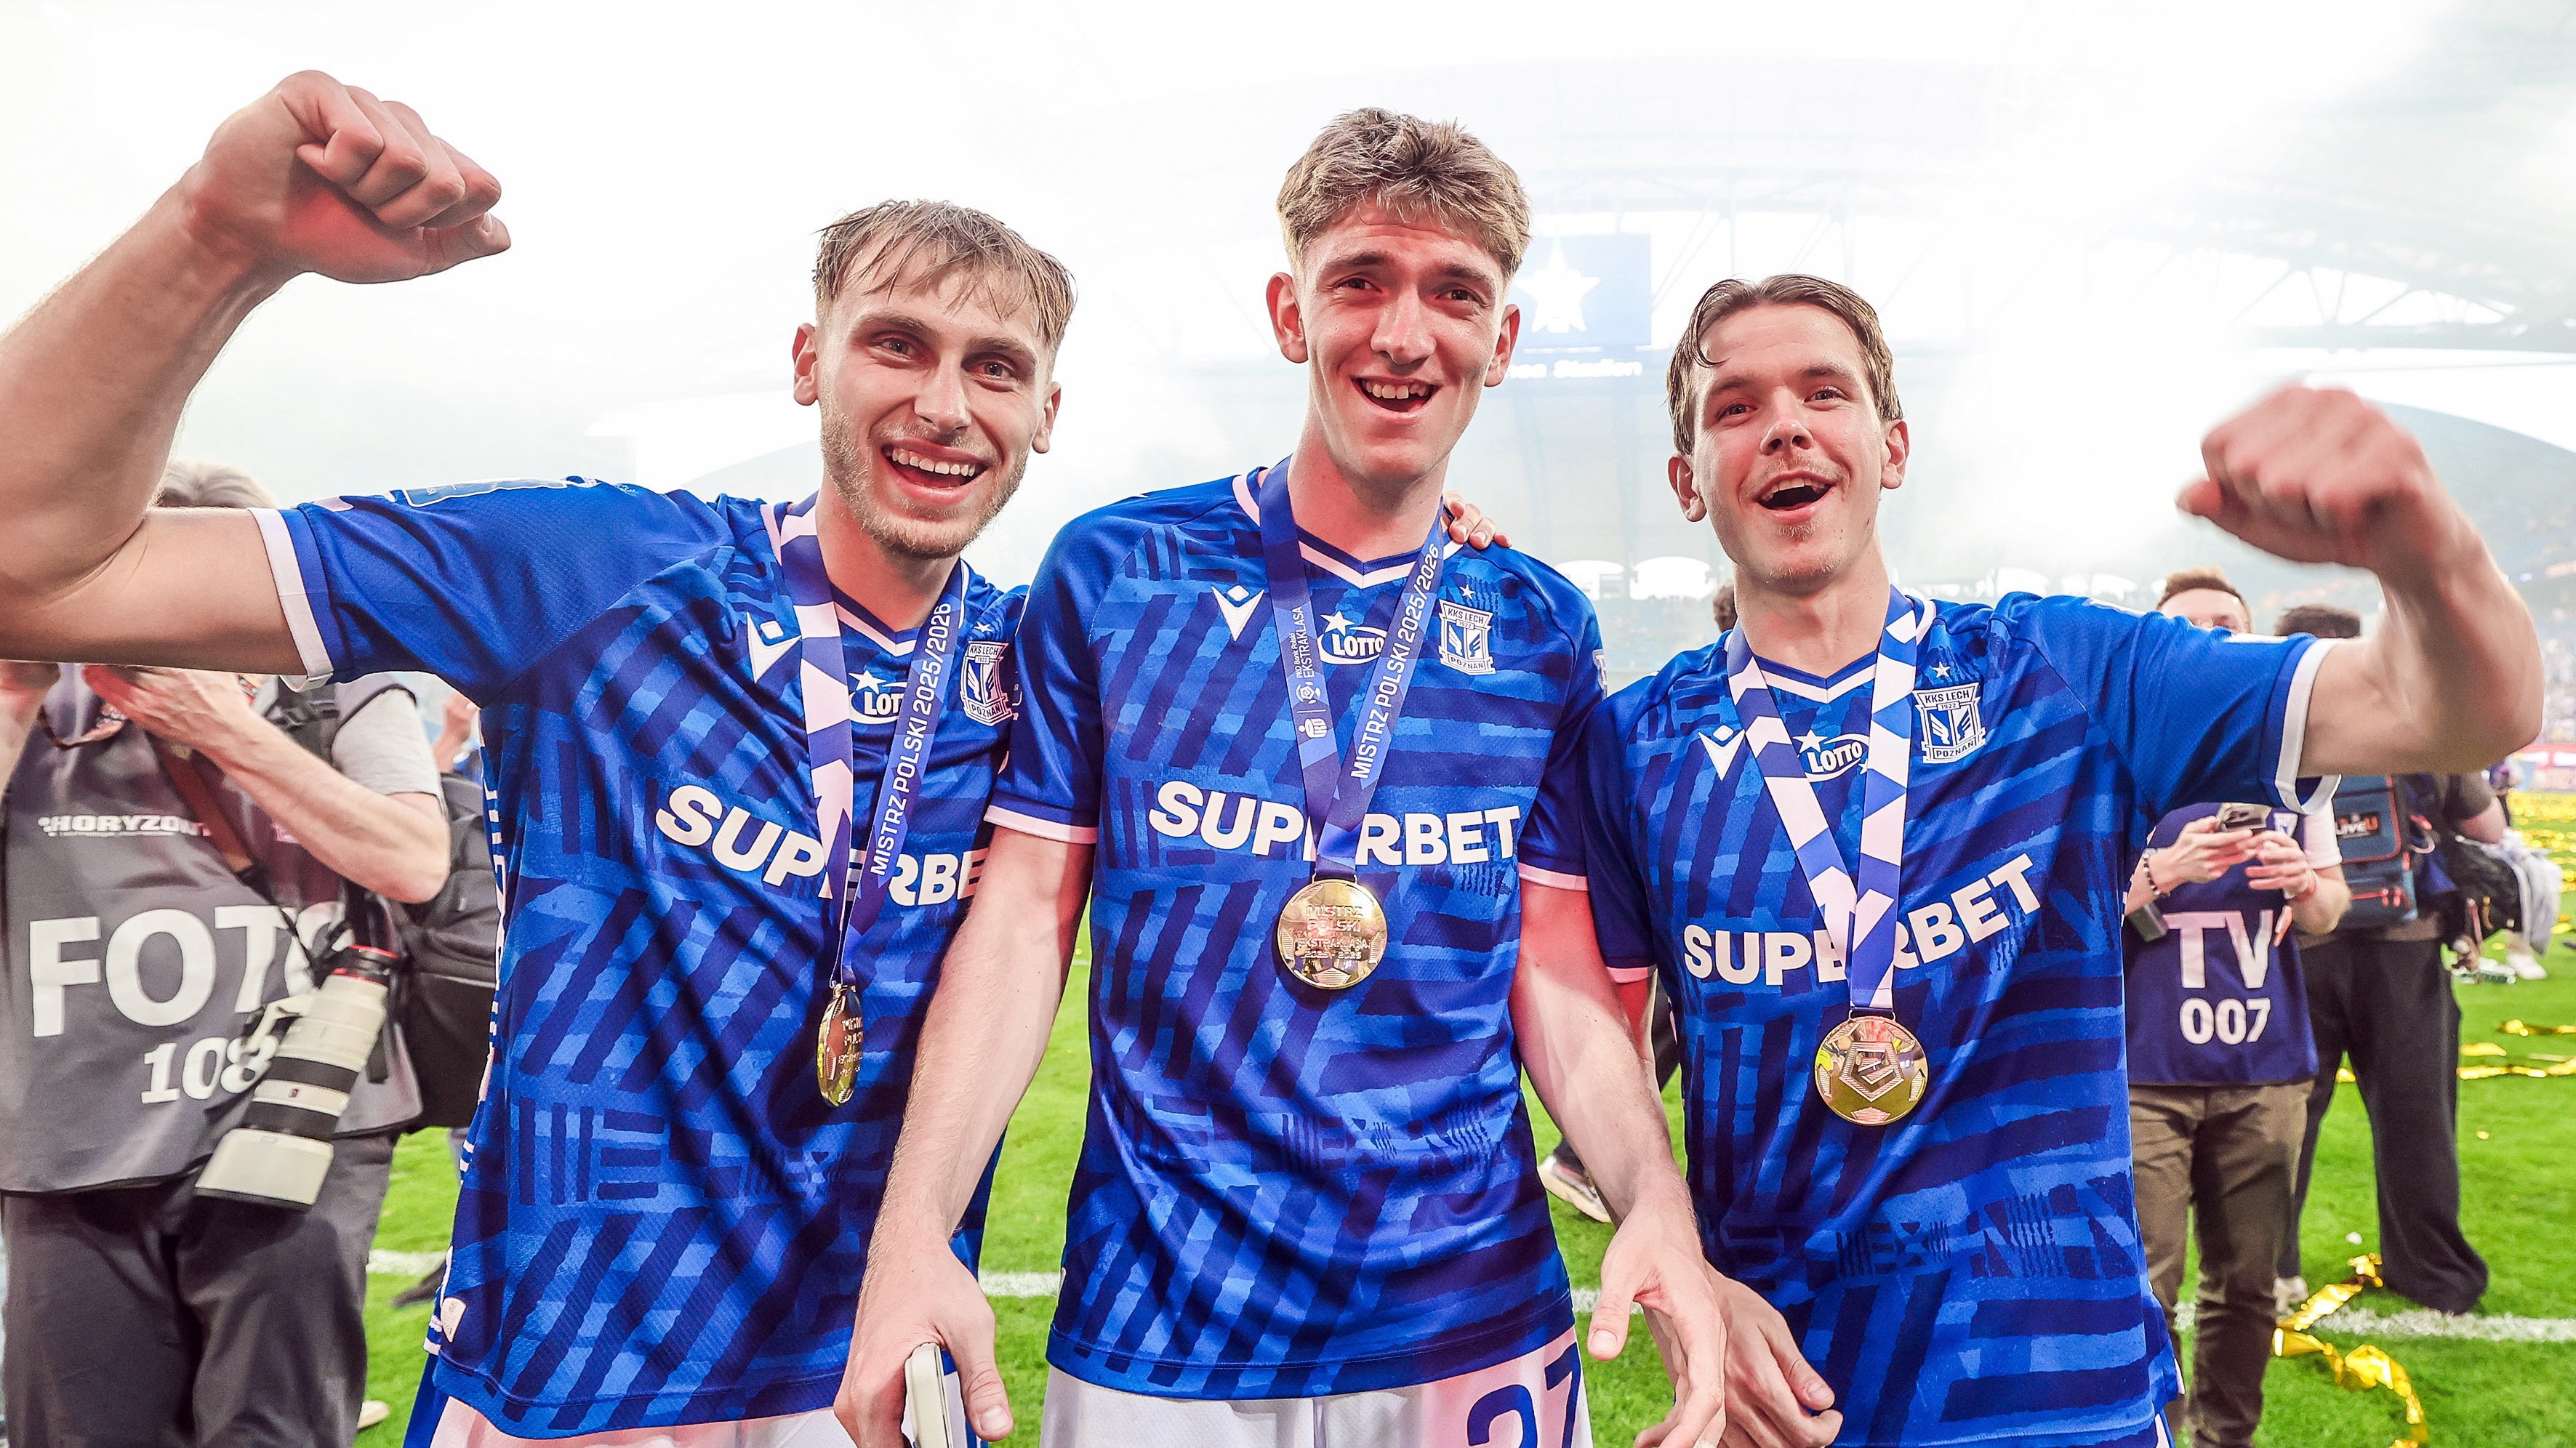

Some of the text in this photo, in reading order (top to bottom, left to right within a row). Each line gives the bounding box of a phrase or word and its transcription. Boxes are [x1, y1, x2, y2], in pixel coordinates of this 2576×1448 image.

[1448, 608, 1484, 624] KKS LECH
[969, 645, 999, 655] KKS LECH
[1291, 606, 1315, 679] EKSTRAKLASA
[1331, 633, 1385, 656] LOTTO
[1350, 543, 1440, 779] MISTRZ POLSKI 2025/2026
[864, 691, 904, 715] LOT
[1925, 689, 1970, 704] KKS LECH
[870, 602, 952, 876] MISTRZ POLSKI 2025/2026
[1807, 741, 1863, 773] LOTTO
[1306, 904, 1364, 917] MISTRZ
[1307, 919, 1362, 933] POLSKI
[2162, 909, 2274, 989] TV
[2180, 997, 2271, 1045] 007
[141, 1035, 280, 1104] 108
